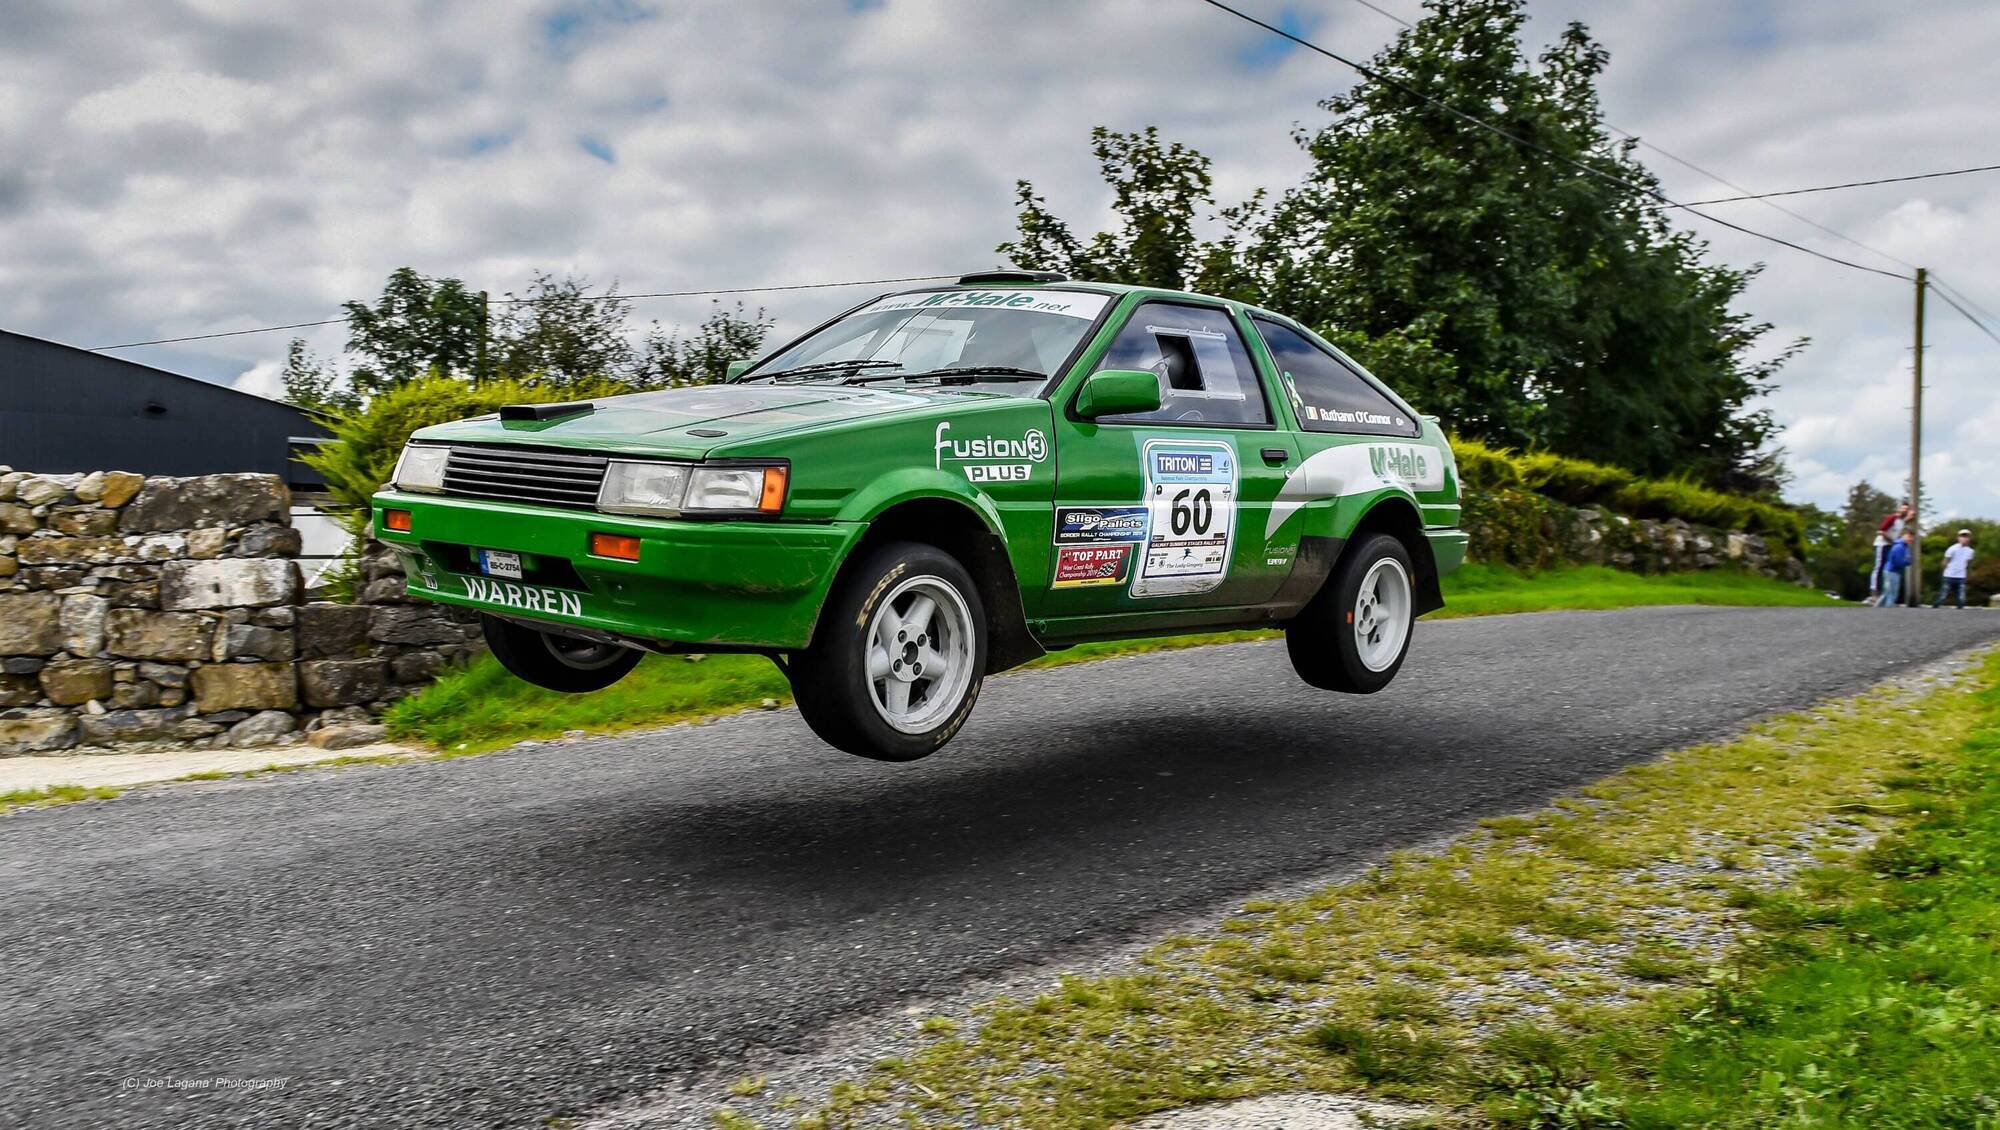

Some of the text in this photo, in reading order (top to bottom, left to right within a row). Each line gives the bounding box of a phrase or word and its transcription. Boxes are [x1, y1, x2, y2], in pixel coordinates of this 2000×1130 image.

[1320, 408, 1391, 425] Ruthann O'Connor
[1158, 456, 1196, 471] TRITON
[971, 466, 1026, 481] PLUS
[1066, 513, 1101, 525] Sligo
[1170, 488, 1213, 536] 60
[1099, 519, 1143, 529] Pallets
[1072, 549, 1123, 562] TOP PART
[461, 576, 582, 617] WARREN
